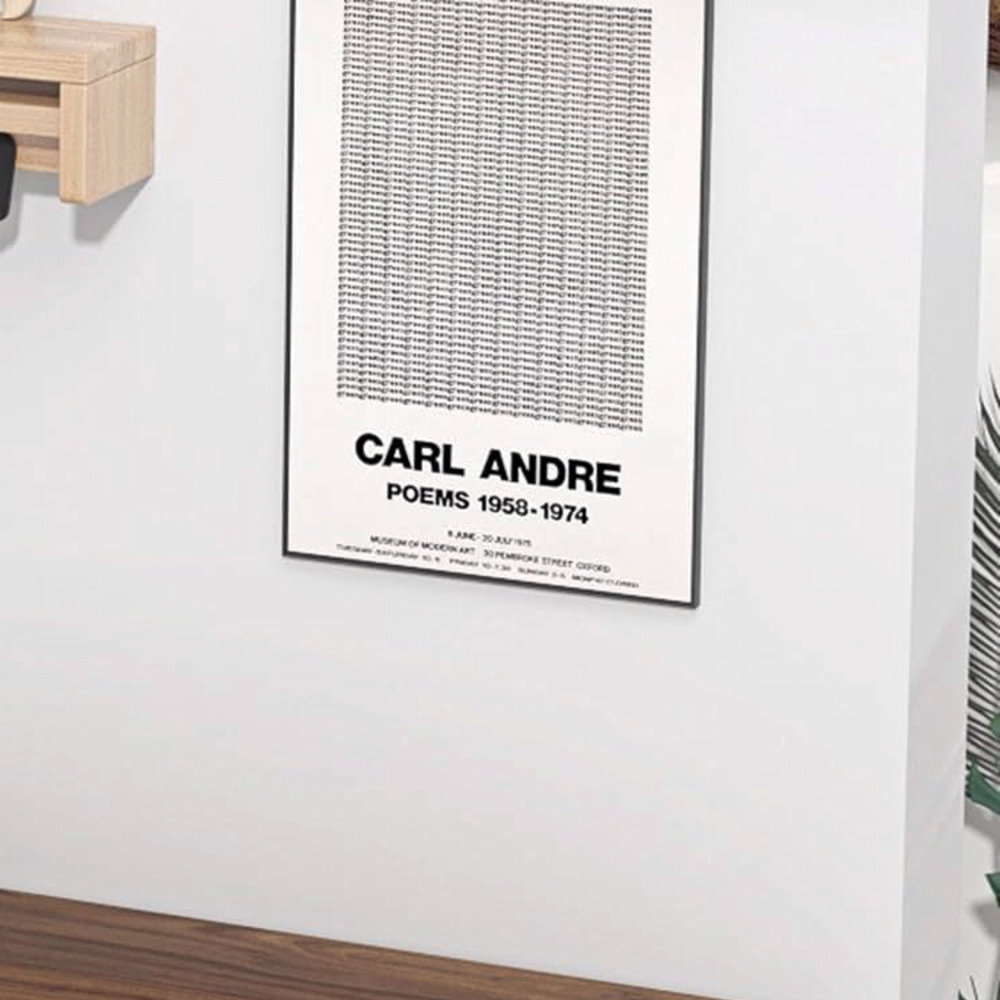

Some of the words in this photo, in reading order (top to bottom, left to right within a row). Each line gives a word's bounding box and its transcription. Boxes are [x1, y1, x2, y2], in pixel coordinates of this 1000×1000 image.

[355, 432, 465, 477] CARL
[480, 448, 622, 496] ANDRE
[386, 483, 470, 510] POEMS
[478, 495, 589, 525] 1958-1974
[370, 535, 407, 546] MUSEUM
[408, 539, 419, 548] OF
[421, 541, 457, 553] MODERN
[542, 556, 573, 568] STREET
[576, 562, 612, 574] OXFORD
